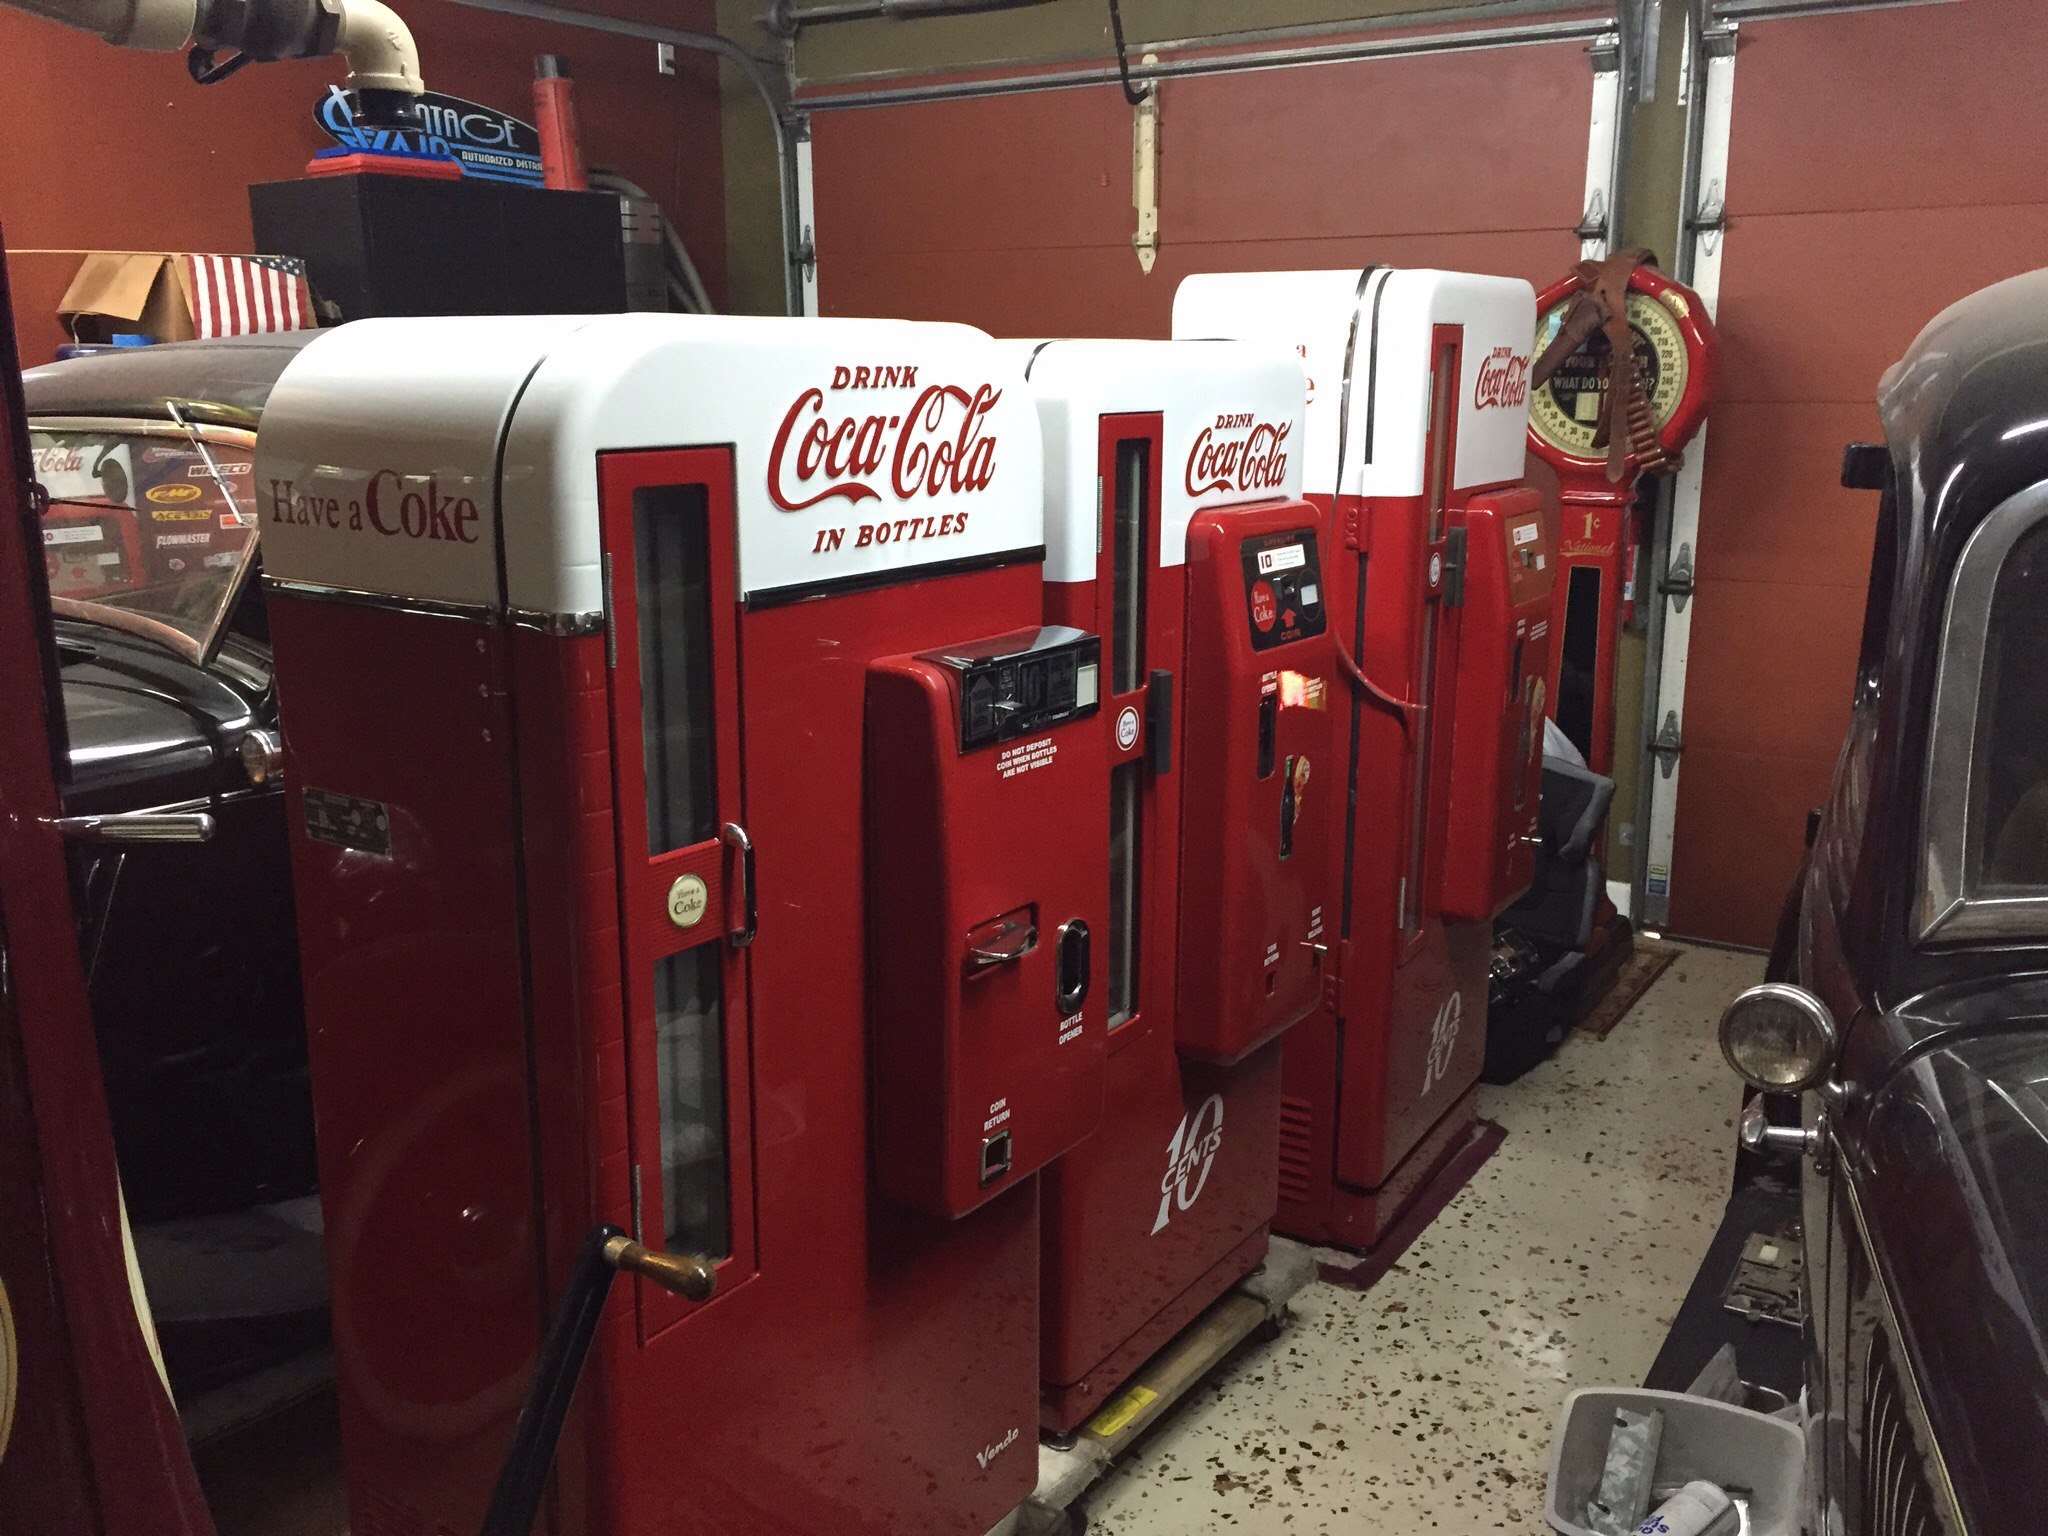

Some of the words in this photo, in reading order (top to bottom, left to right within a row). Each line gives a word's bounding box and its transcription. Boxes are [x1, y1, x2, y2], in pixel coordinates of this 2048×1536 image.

[461, 150, 514, 168] AUTHORIZED
[831, 365, 919, 390] DRINK
[1553, 377, 1580, 389] WHAT
[1582, 377, 1595, 389] DO
[1214, 413, 1255, 429] DRINK
[767, 383, 1003, 513] Coca-Cola
[1185, 419, 1293, 497] Coca-Cola
[269, 479, 340, 529] Have
[350, 500, 363, 531] a
[366, 468, 479, 544] Coke
[156, 533, 210, 549] FLOWMASTER
[812, 528, 845, 553] IN
[854, 512, 968, 548] BOTTLES
[1560, 540, 1615, 556] National
[1260, 554, 1273, 570] 10
[1253, 605, 1274, 623] Coke
[996, 760, 1012, 771] COIN
[1012, 754, 1031, 766] WHEN
[1031, 745, 1058, 760] BOTTLES
[1001, 750, 1011, 760] DO
[1012, 745, 1025, 756] NOT
[1026, 738, 1052, 753] DEPOSIT
[1002, 768, 1016, 779] ARE
[1016, 763, 1029, 774] NOT
[1030, 756, 1053, 770] VISIBLE
[674, 898, 703, 916] Coke
[1059, 1011, 1083, 1031] BOTTLE
[1058, 1025, 1083, 1045] OPENER
[1420, 990, 1461, 1097] 10
[989, 1097, 1007, 1114] COIN
[983, 1108, 1011, 1132] RETURN
[1150, 1093, 1225, 1237] 10
[1161, 1126, 1223, 1194] CENTS
[976, 1428, 1019, 1469] Vendo
